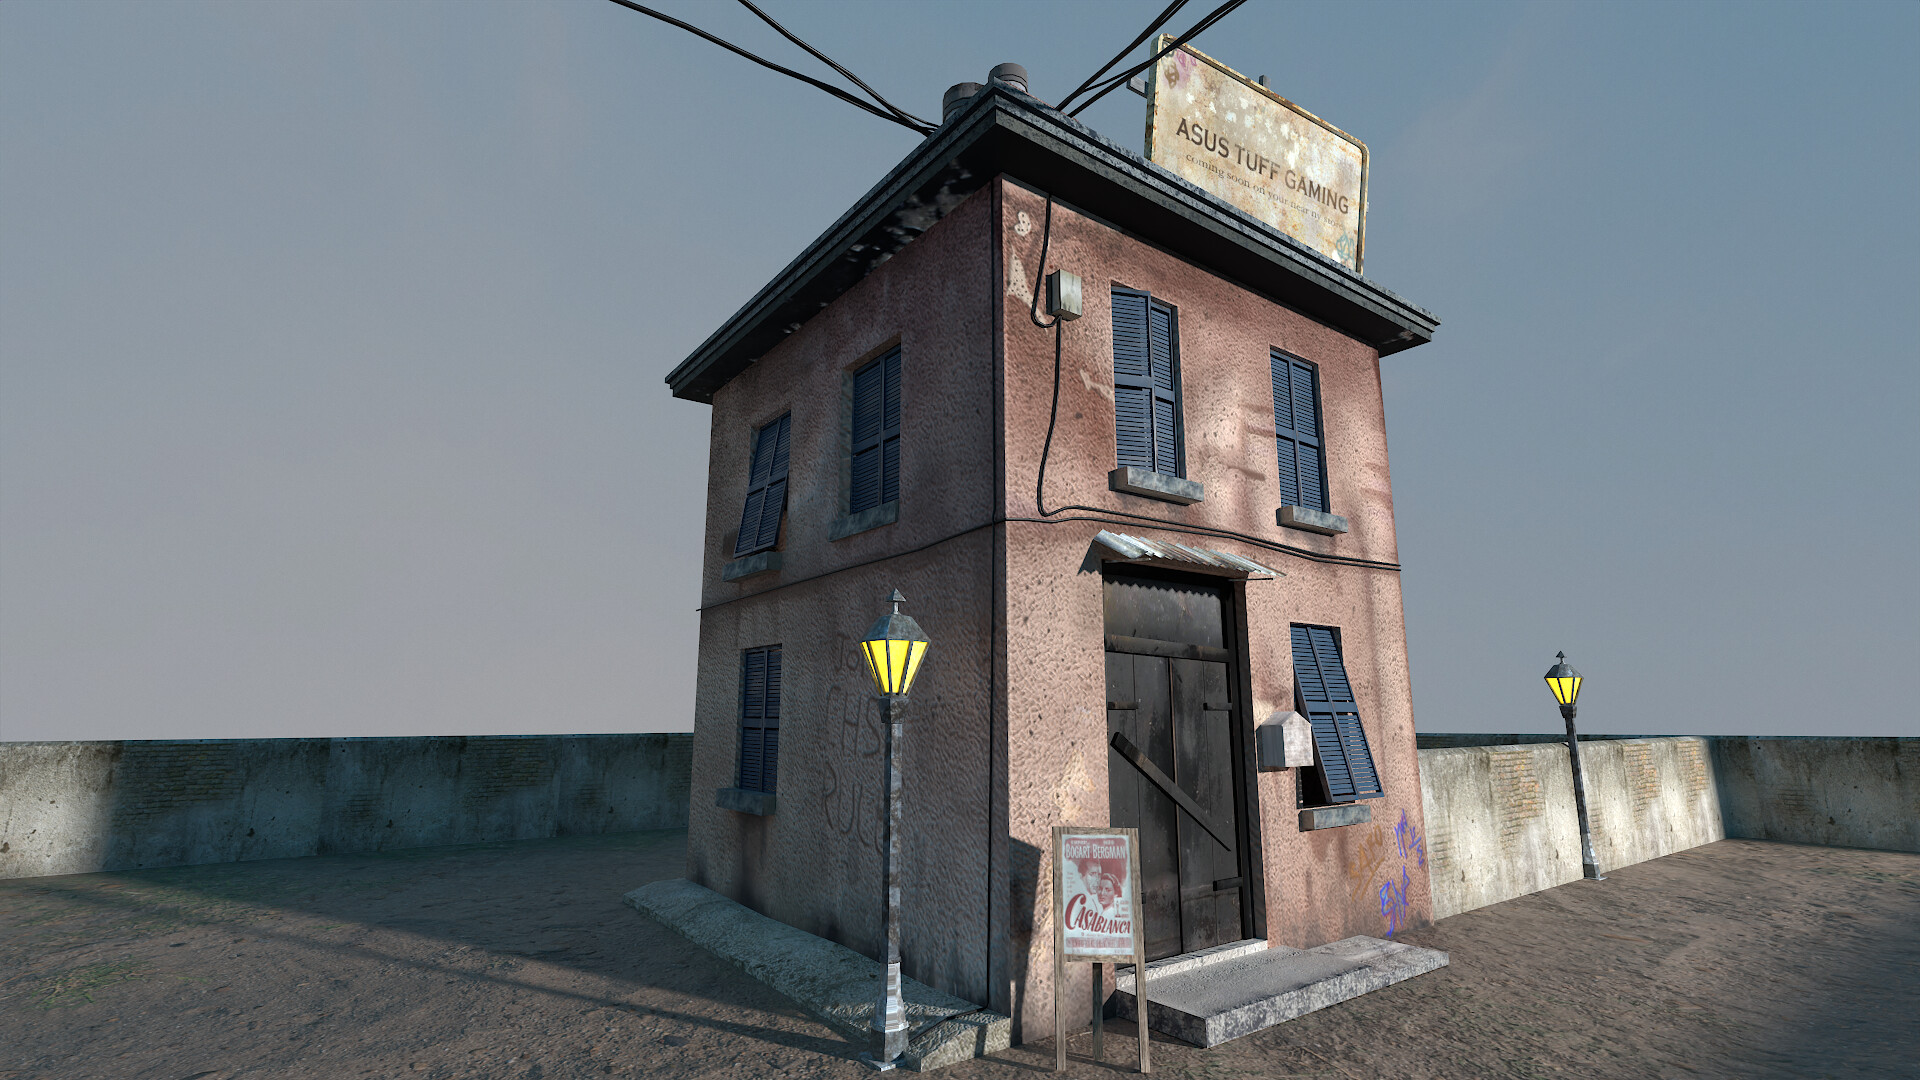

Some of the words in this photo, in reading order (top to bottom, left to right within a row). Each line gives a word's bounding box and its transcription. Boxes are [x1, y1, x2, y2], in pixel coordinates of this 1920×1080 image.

[1176, 117, 1230, 159] ASUS
[1234, 143, 1281, 180] TUFF
[1284, 169, 1349, 215] GAMING
[1185, 154, 1225, 179] coming
[1227, 172, 1250, 188] soon
[1253, 185, 1266, 195] on
[1268, 191, 1289, 205] your
[1065, 843, 1091, 860] BOGART
[1092, 843, 1126, 860] BERGMAN
[1064, 893, 1131, 935] CASABLANCA
